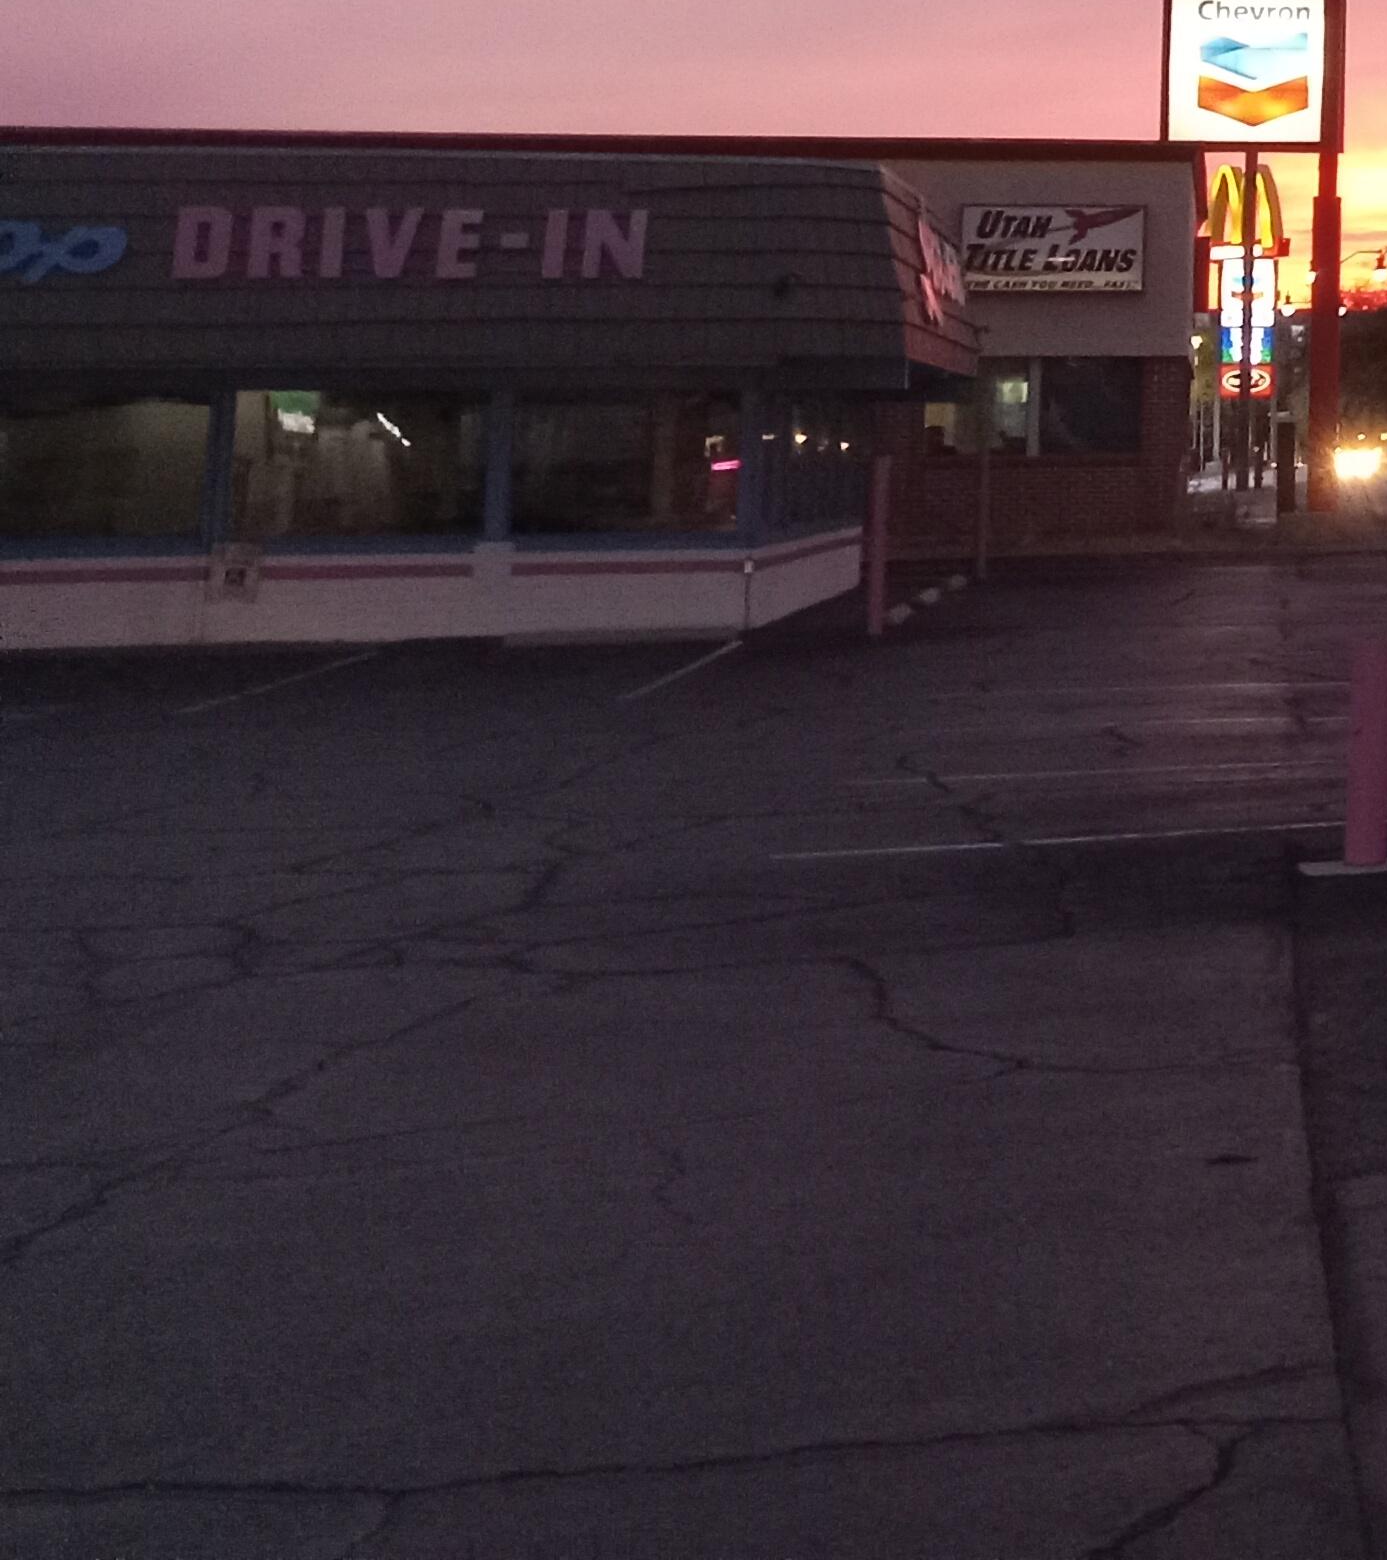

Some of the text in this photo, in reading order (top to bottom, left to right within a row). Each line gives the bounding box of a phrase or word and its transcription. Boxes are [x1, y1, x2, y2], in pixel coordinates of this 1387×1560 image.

[1197, 0, 1311, 21] Chevron
[976, 209, 1053, 239] UTAH
[171, 205, 649, 280] DRIVE-IN
[965, 243, 1138, 273] TITLE LOANS
